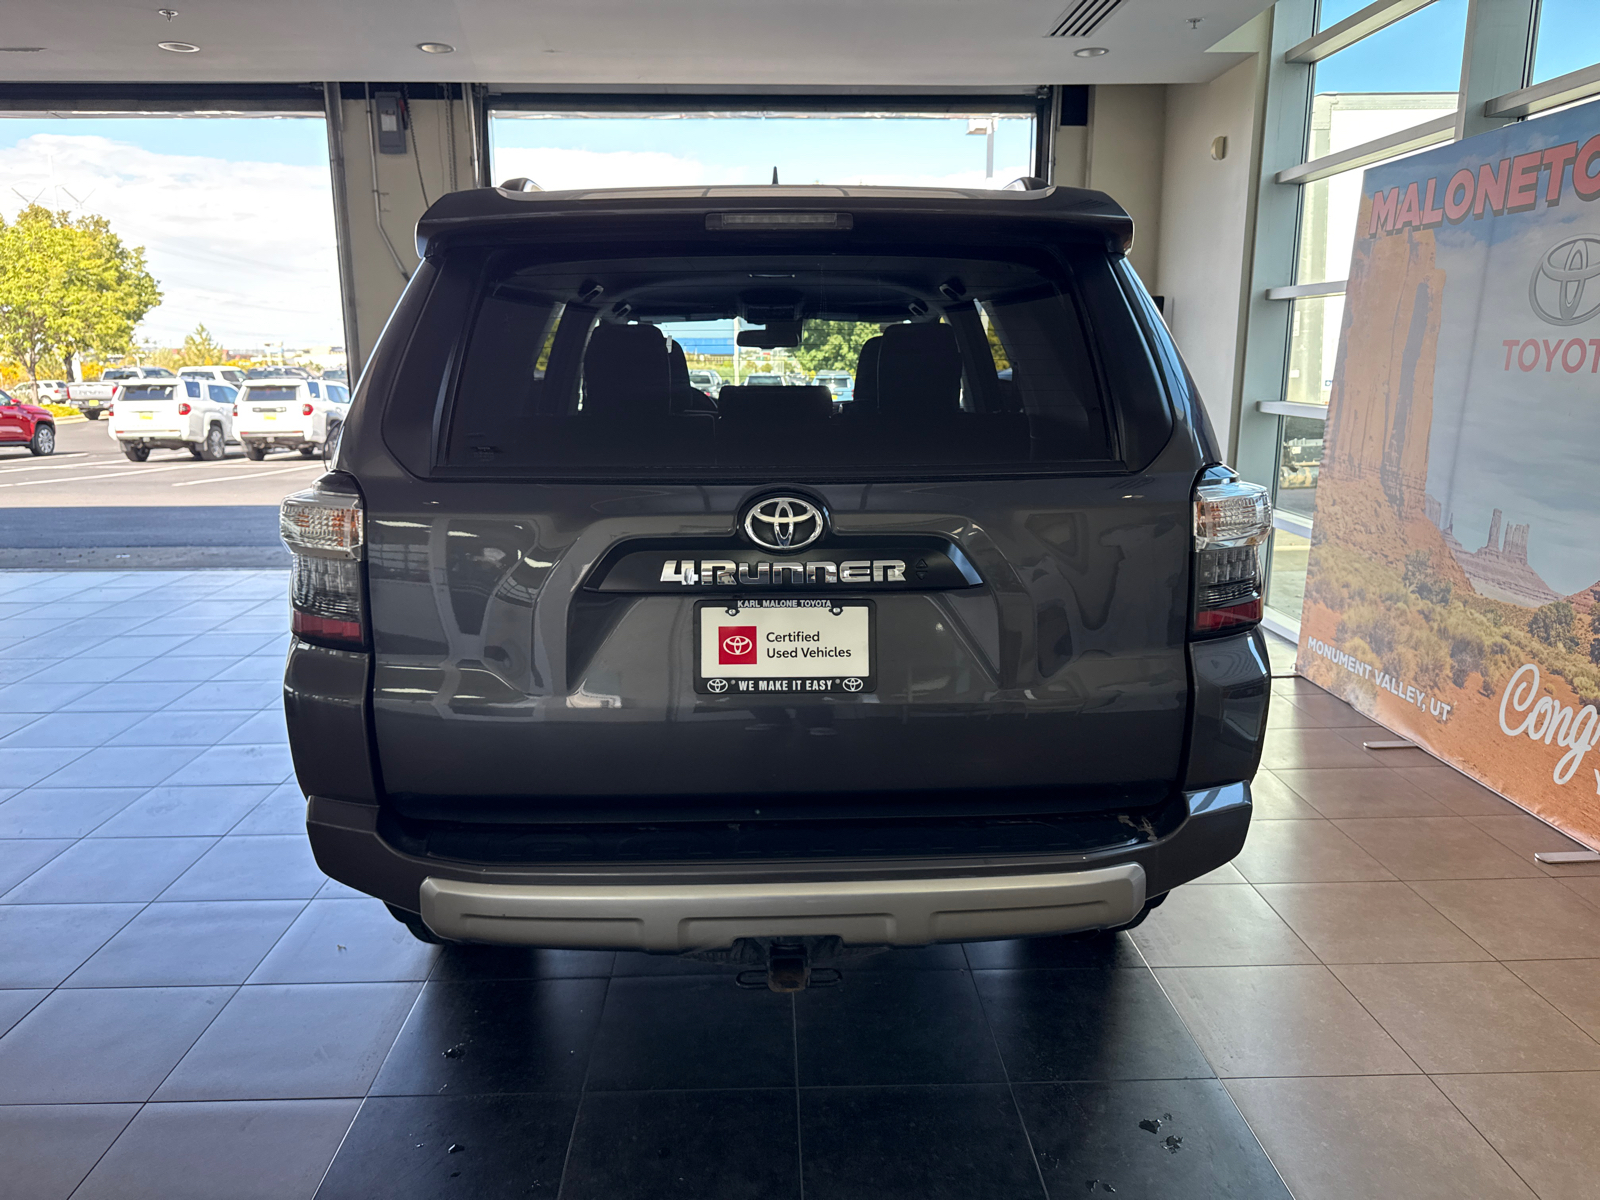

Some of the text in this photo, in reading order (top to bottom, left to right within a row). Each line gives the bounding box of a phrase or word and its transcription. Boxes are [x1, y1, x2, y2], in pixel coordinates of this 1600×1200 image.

[737, 599, 832, 609] KARL MALONE TOYOTA
[766, 631, 821, 643] Certified
[766, 646, 852, 659] Used Vehicles
[1307, 635, 1452, 721] MONUMENT VALLEY, UT
[738, 680, 833, 691] WE MAKE IT EASY
